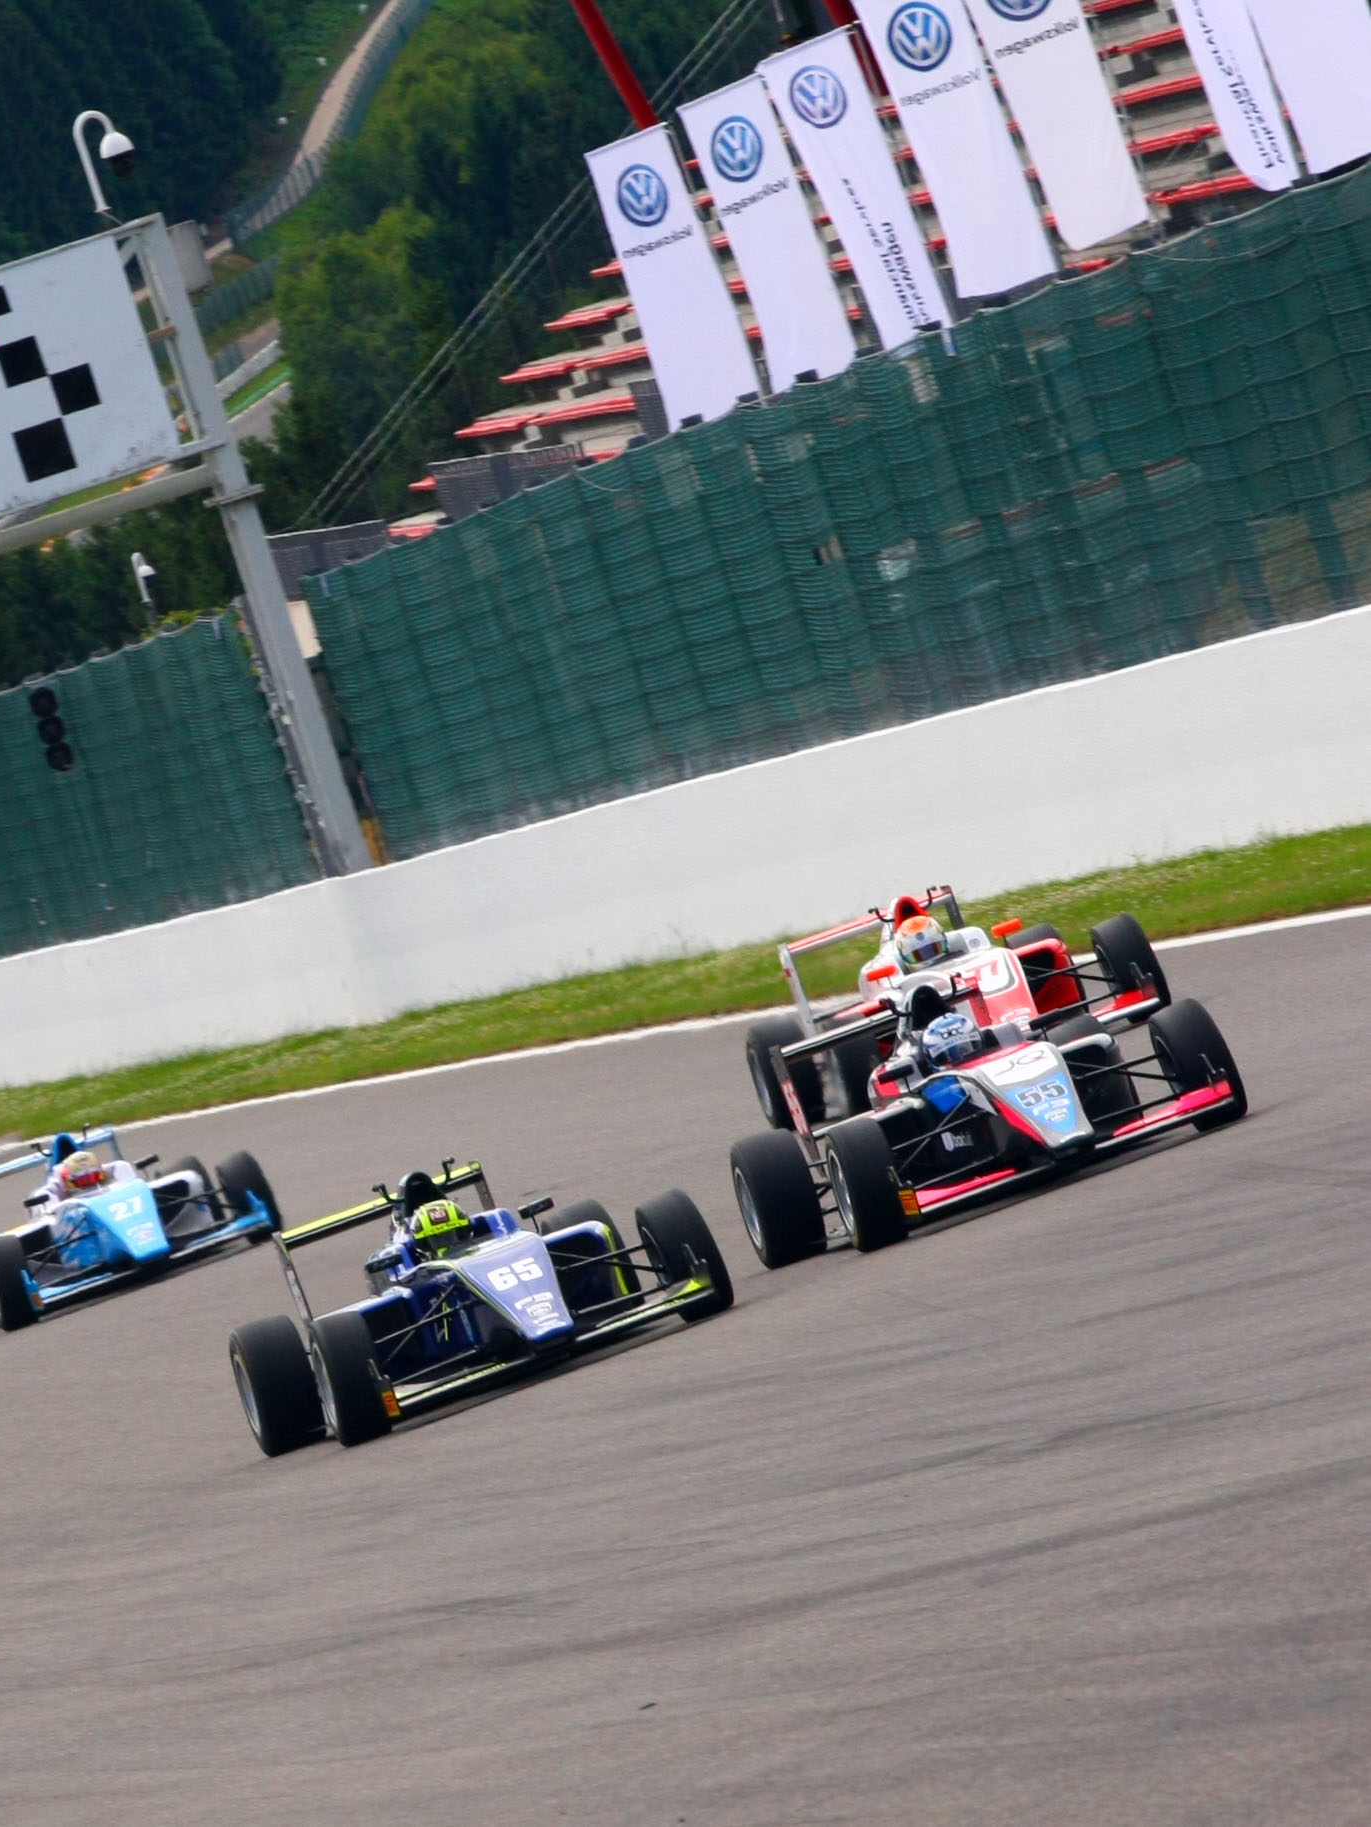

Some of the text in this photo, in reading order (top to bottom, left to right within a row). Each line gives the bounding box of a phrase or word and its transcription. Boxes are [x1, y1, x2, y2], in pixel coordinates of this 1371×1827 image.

[1016, 1080, 1068, 1108] 55
[108, 1196, 143, 1221] 27
[487, 1257, 543, 1292] 65
